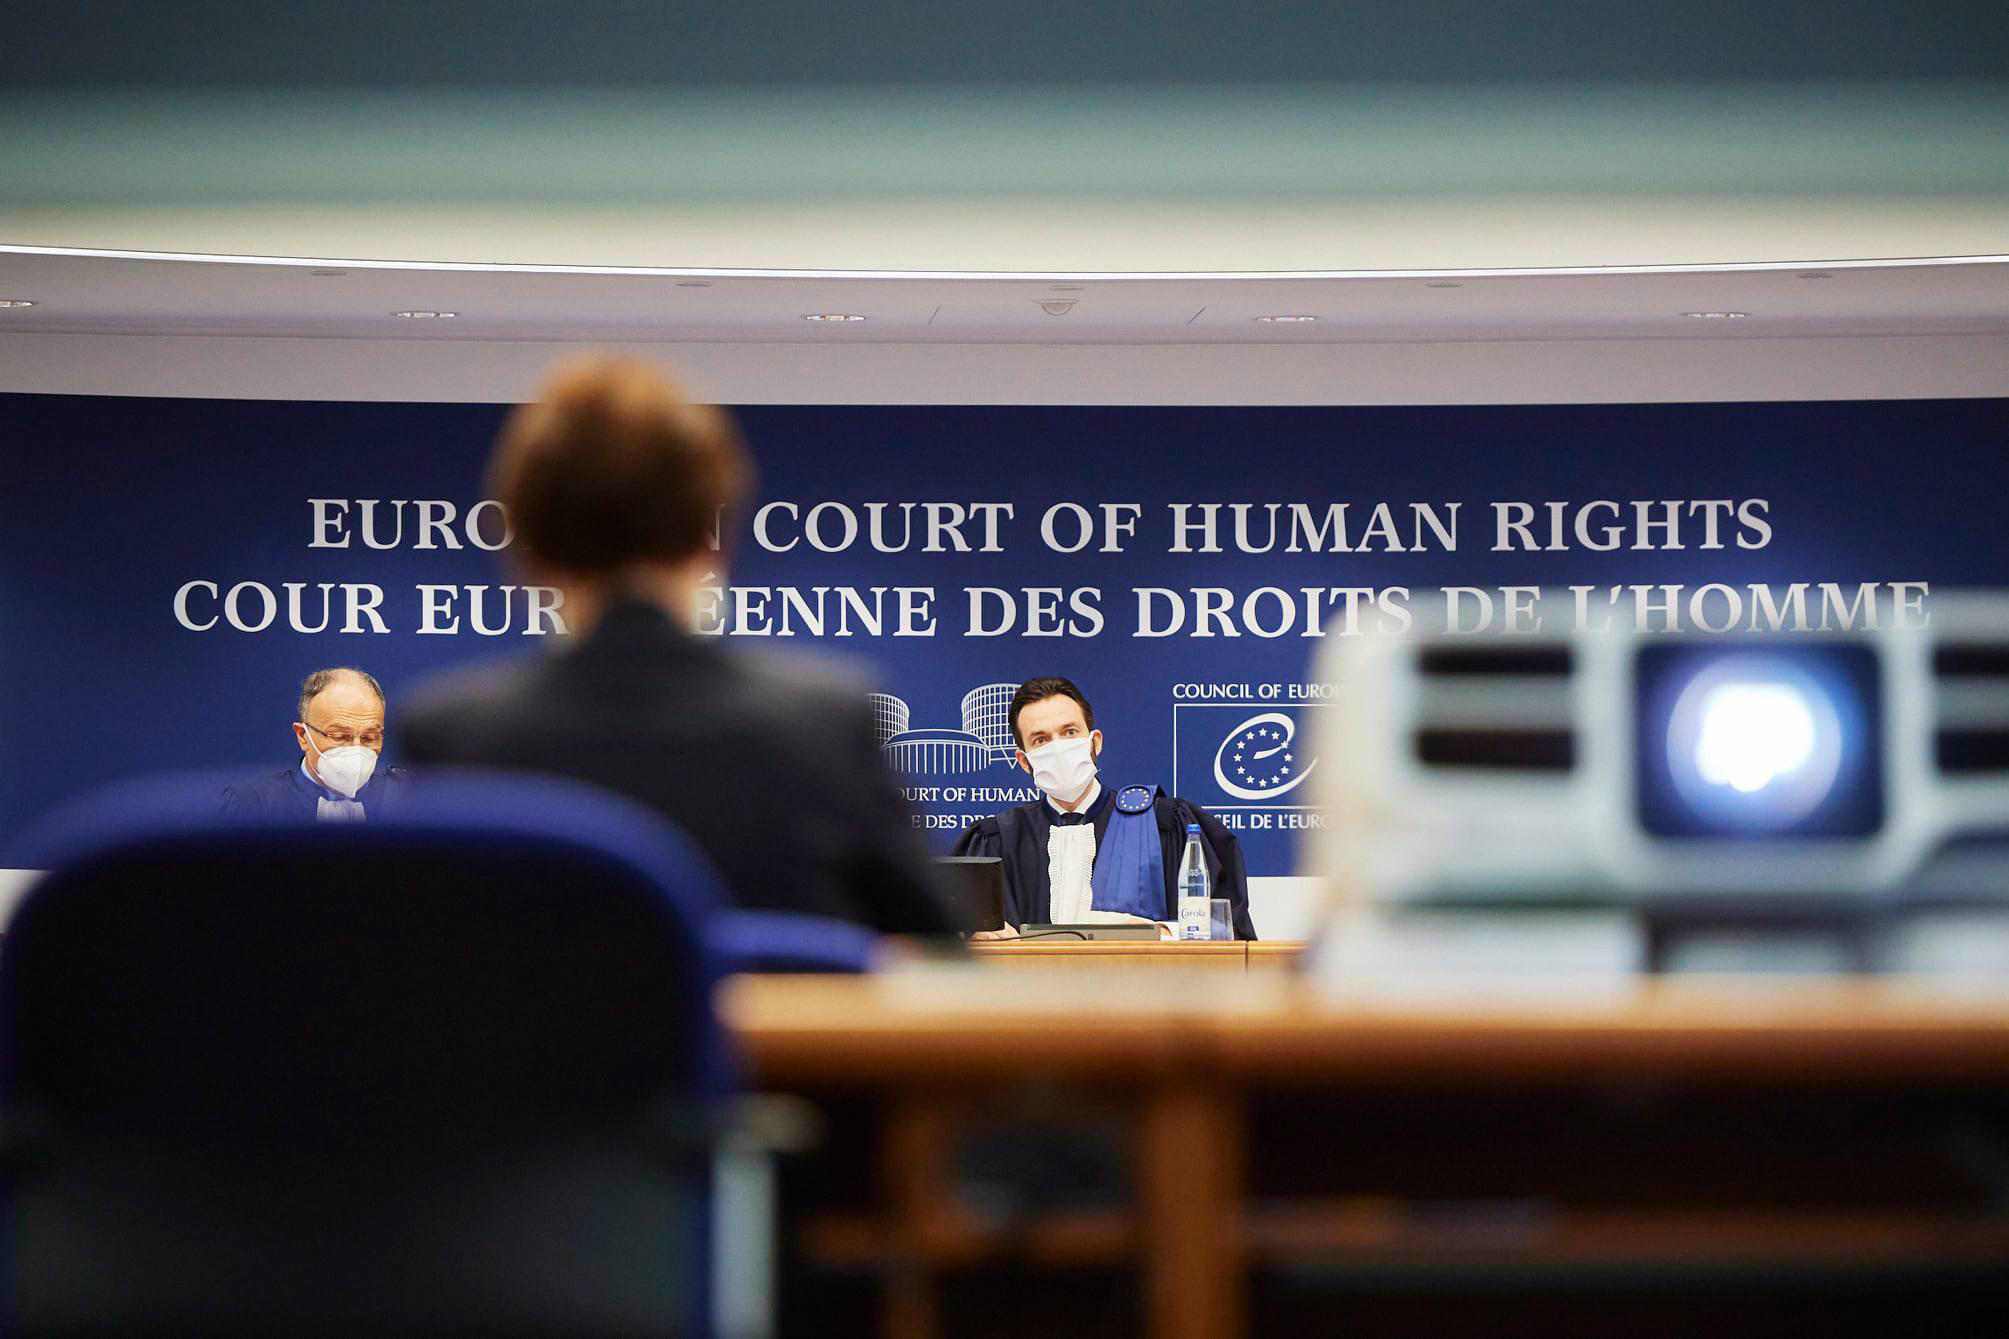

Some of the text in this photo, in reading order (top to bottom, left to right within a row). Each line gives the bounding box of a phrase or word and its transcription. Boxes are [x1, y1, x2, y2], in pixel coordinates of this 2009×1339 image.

[753, 501, 1014, 553] COURT
[1040, 502, 1142, 553] OF
[1168, 502, 1462, 553] HUMAN
[1490, 498, 1773, 551] RIGHTS
[173, 571, 1932, 638] COUR EURÉENNE DES DROITS DE L'HOMME
[1172, 683, 1254, 699] COUNCIL
[1258, 683, 1282, 699] OF
[943, 787, 967, 802] OF
[971, 787, 1041, 802] HUMAN
[925, 814, 958, 829] DES
[1250, 814, 1273, 830] DE
